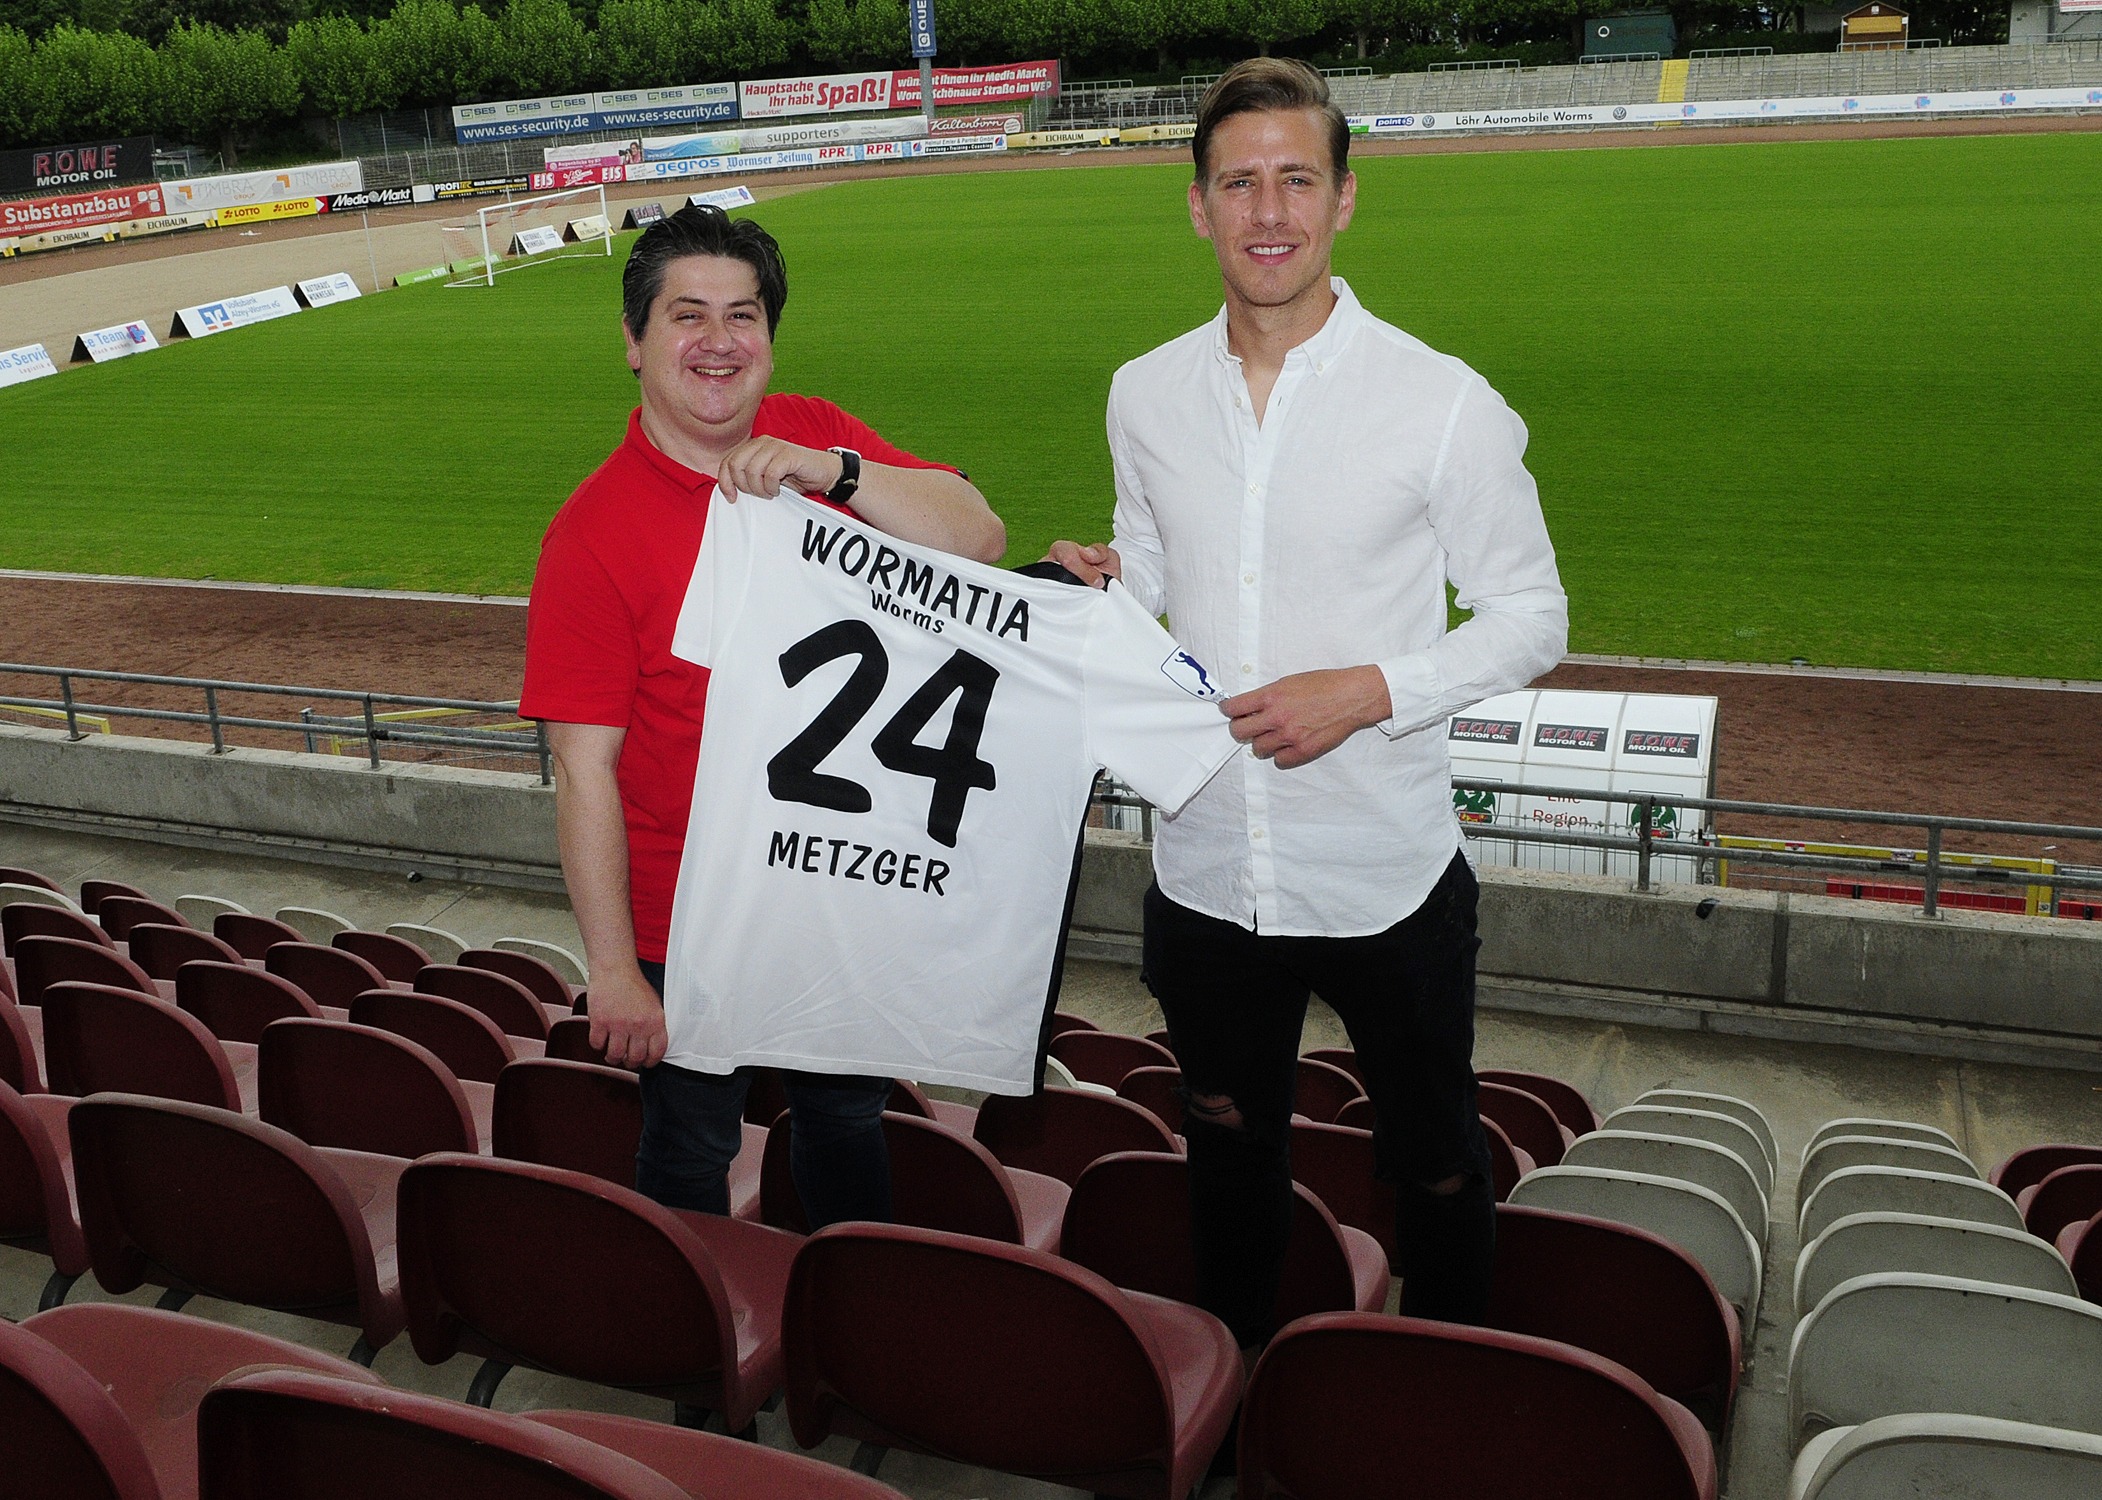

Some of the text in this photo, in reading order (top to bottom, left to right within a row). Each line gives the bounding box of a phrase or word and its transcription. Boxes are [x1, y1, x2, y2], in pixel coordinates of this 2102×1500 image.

[940, 74, 968, 85] Ihnen
[970, 72, 984, 83] Ihr
[985, 70, 1015, 82] Media
[1016, 67, 1047, 79] Markt
[661, 90, 683, 99] SES
[706, 86, 728, 95] SES
[745, 81, 813, 96] Hauptsache
[816, 78, 887, 110] Spaß!
[983, 83, 1015, 95] Straße
[1016, 83, 1029, 93] im
[564, 98, 586, 107] SES
[615, 94, 637, 103] SES
[769, 93, 814, 107] Ihr habt
[474, 106, 496, 116] SES
[519, 102, 541, 111] SES
[603, 103, 730, 125] www.ses-security.de
[929, 117, 1005, 132] Kaltenborn
[1455, 111, 1593, 126] Löhr Automobile Worms
[463, 115, 589, 138] www.ses-security.de
[1168, 127, 1197, 136] EICHBA
[767, 126, 839, 144] supporters
[1045, 133, 1084, 143] EICHBAUM
[34, 145, 118, 177] ROWE
[727, 149, 813, 169] Wormser Zeitung
[602, 166, 622, 182] EIS
[655, 158, 720, 176] gegros
[37, 168, 117, 187] MOTOR OIL
[294, 167, 352, 186] TIMBRA
[534, 173, 555, 189] EIS
[194, 178, 254, 198] TIMBRA
[332, 193, 369, 208] Media
[377, 188, 411, 202] Markt
[5, 195, 131, 224] Substanzbau
[234, 207, 261, 217] LOTTO
[283, 201, 310, 212] LOTTO
[147, 216, 188, 230] EICHBAUM
[53, 231, 90, 243] EICHBAUM
[94, 330, 126, 345] Team
[801, 518, 1030, 642] WORMATIA
[870, 589, 944, 635] Worms
[766, 619, 1000, 849] 24
[1454, 720, 1515, 736] ROWE
[1538, 727, 1600, 742] ROWE
[1453, 731, 1508, 741] MOTOR OIL
[1538, 737, 1595, 747] MOTOR OIL
[1628, 733, 1693, 749] ROWE
[1628, 744, 1686, 754] MOTOR OIL
[767, 831, 951, 897] METZGER
